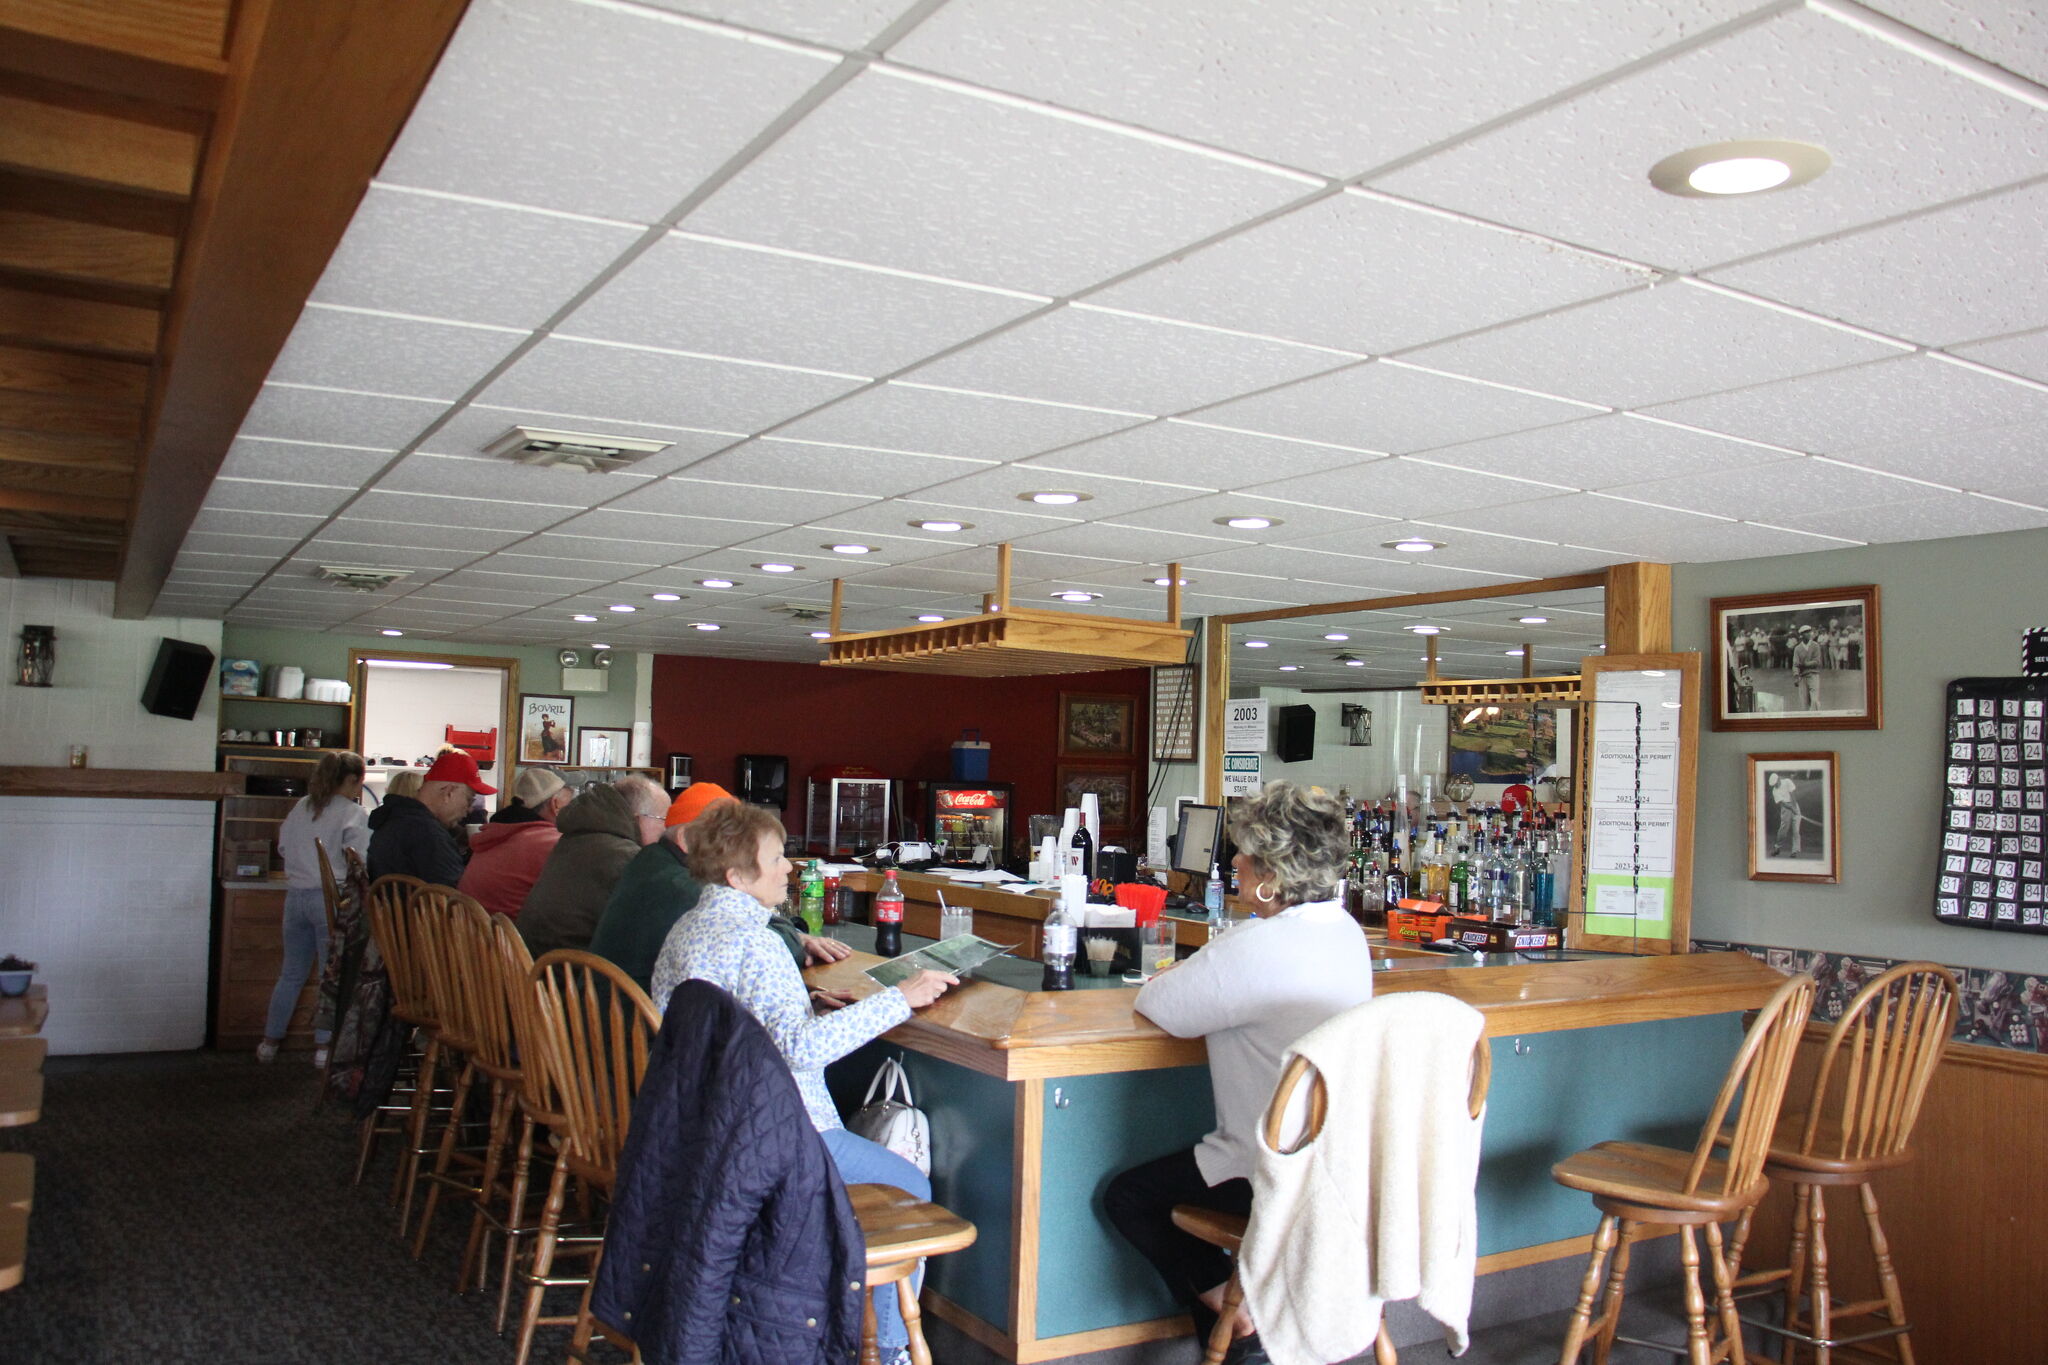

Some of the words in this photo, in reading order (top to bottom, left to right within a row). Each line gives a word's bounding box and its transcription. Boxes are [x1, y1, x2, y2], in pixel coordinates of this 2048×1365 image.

[529, 703, 566, 715] BOVRIL
[1234, 707, 1258, 721] 2003
[1983, 700, 1991, 714] 2
[2006, 701, 2013, 714] 3
[1960, 724, 1973, 737] 11
[1980, 723, 1993, 737] 12
[2003, 725, 2017, 739] 13
[2024, 724, 2038, 737] 14
[1954, 745, 1968, 758] 21
[1980, 747, 1993, 760] 22
[2003, 747, 2017, 760] 23
[2026, 745, 2040, 758] 24
[1225, 775, 1232, 783] WE
[1232, 775, 1247, 783] VALUE
[1951, 769, 1965, 781] 31
[1979, 770, 1992, 782] 32
[2002, 771, 2017, 784] 33
[2028, 772, 2042, 785] 34
[1977, 793, 1991, 806] 42
[2004, 794, 2018, 807] 43
[2027, 792, 2041, 806] 44
[1952, 813, 1967, 826] 51
[1976, 816, 1991, 829] 52
[2001, 816, 2015, 829] 53
[2023, 817, 2038, 831] 54
[1946, 834, 1960, 847] 61
[1970, 838, 1986, 851] 62
[2002, 839, 2017, 852] 63
[2023, 837, 2037, 850] 64
[1948, 857, 1962, 871] 71
[1975, 859, 1990, 873] 72
[1998, 862, 2013, 876] 73
[2025, 862, 2039, 876] 74
[1943, 878, 1957, 890] 81
[1973, 881, 1989, 895] 82
[1998, 880, 2014, 895] 83
[2025, 884, 2040, 898] 84
[1941, 900, 1956, 913] 91
[1969, 903, 1986, 916] 92
[1998, 903, 2014, 917] 93
[2023, 909, 2039, 922] 94
[1464, 931, 1487, 943] SNICKERS
[1517, 935, 1545, 947] SNICKERS
